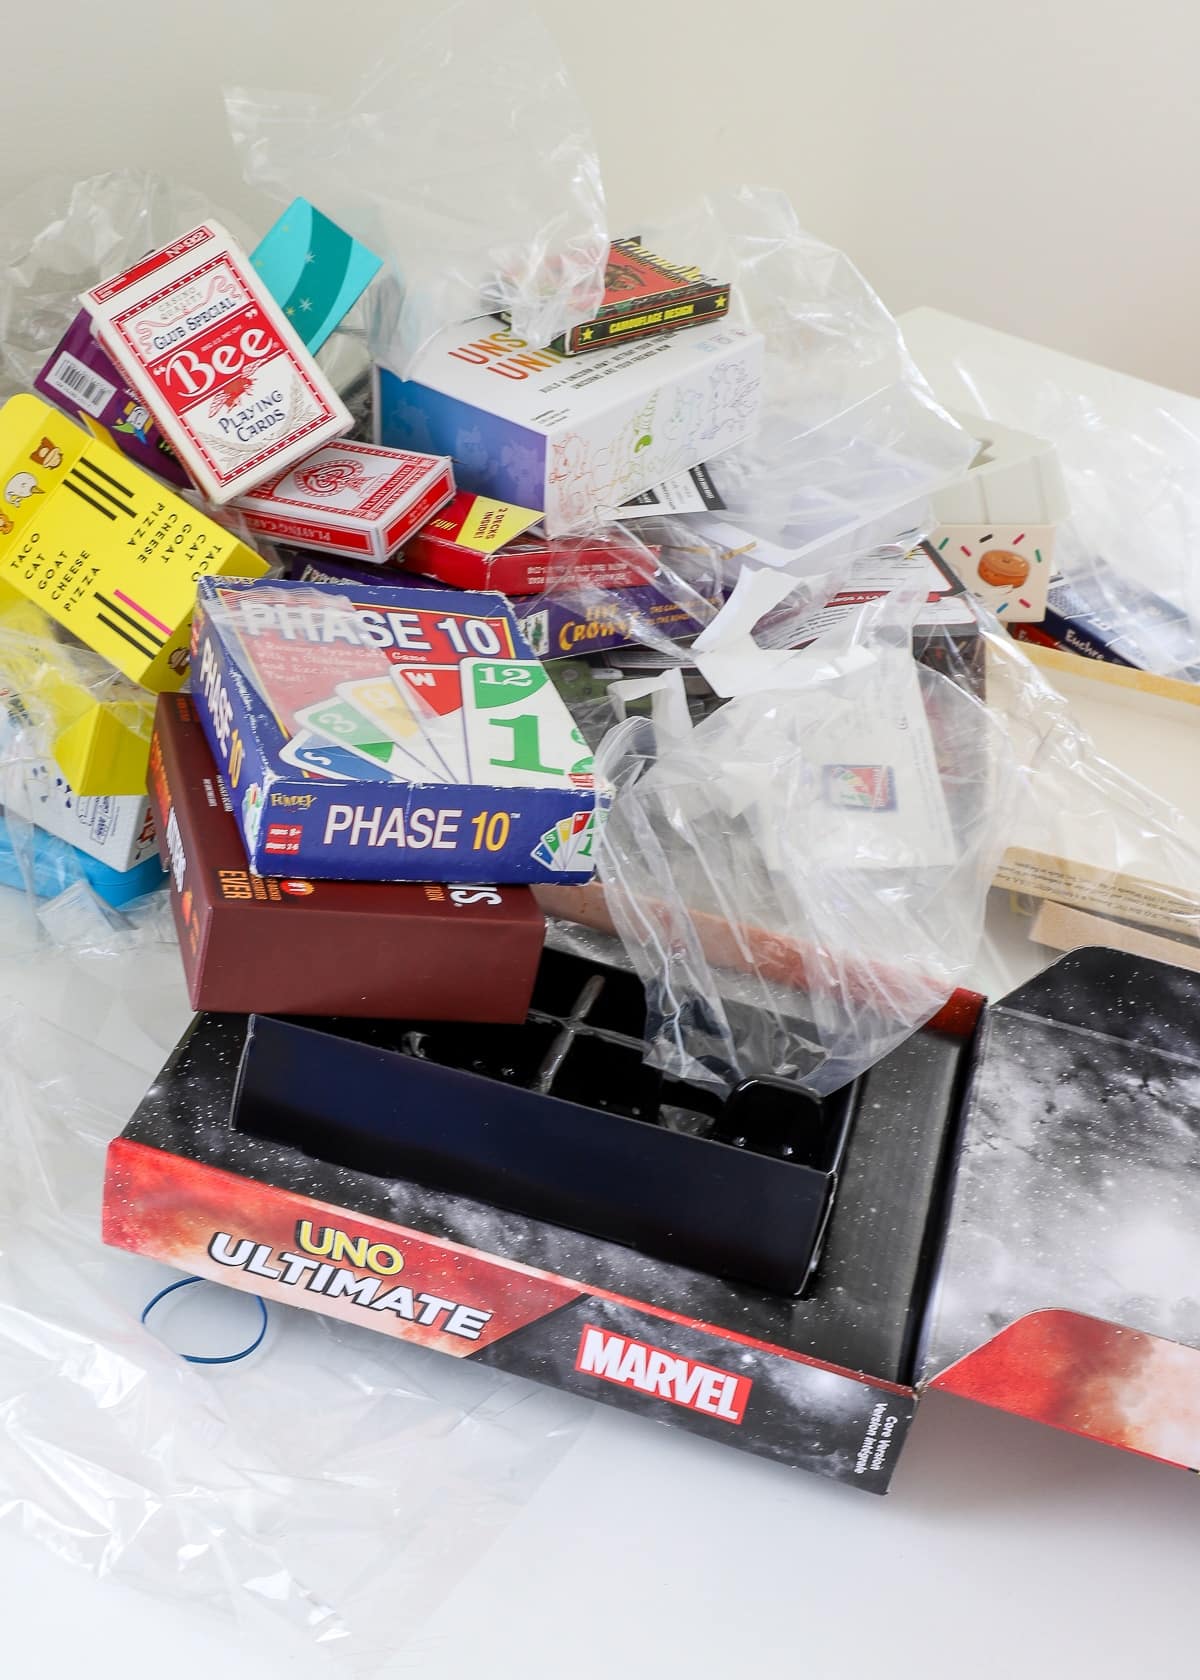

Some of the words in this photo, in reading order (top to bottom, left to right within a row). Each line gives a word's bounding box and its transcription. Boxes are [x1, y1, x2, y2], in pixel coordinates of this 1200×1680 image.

[153, 327, 187, 350] CLUB
[186, 297, 237, 331] SPECIAL
[448, 330, 528, 364] UNS
[218, 389, 283, 434] PLAYING
[237, 408, 286, 442] CARDS
[127, 502, 165, 547] PIZZA
[137, 513, 178, 564] CHEESE
[162, 523, 193, 564] GOAT
[11, 533, 41, 569] TACO
[25, 553, 46, 580] CAT
[185, 534, 207, 561] CAT
[191, 545, 223, 582] TACO
[38, 551, 69, 591] GOAT
[51, 550, 90, 600] CHEESE
[64, 566, 101, 612] PIZZA
[240, 600, 432, 650] PHASE
[478, 667, 533, 687] 12
[323, 804, 462, 850] PHASE
[218, 869, 253, 900] EVER
[298, 1218, 405, 1276] UNO
[208, 1231, 494, 1342] ULTIMATE
[579, 1329, 740, 1421] MARVEL
[867, 1402, 889, 1437] Version
[883, 1415, 899, 1439] Core
[869, 1436, 892, 1472] Version
